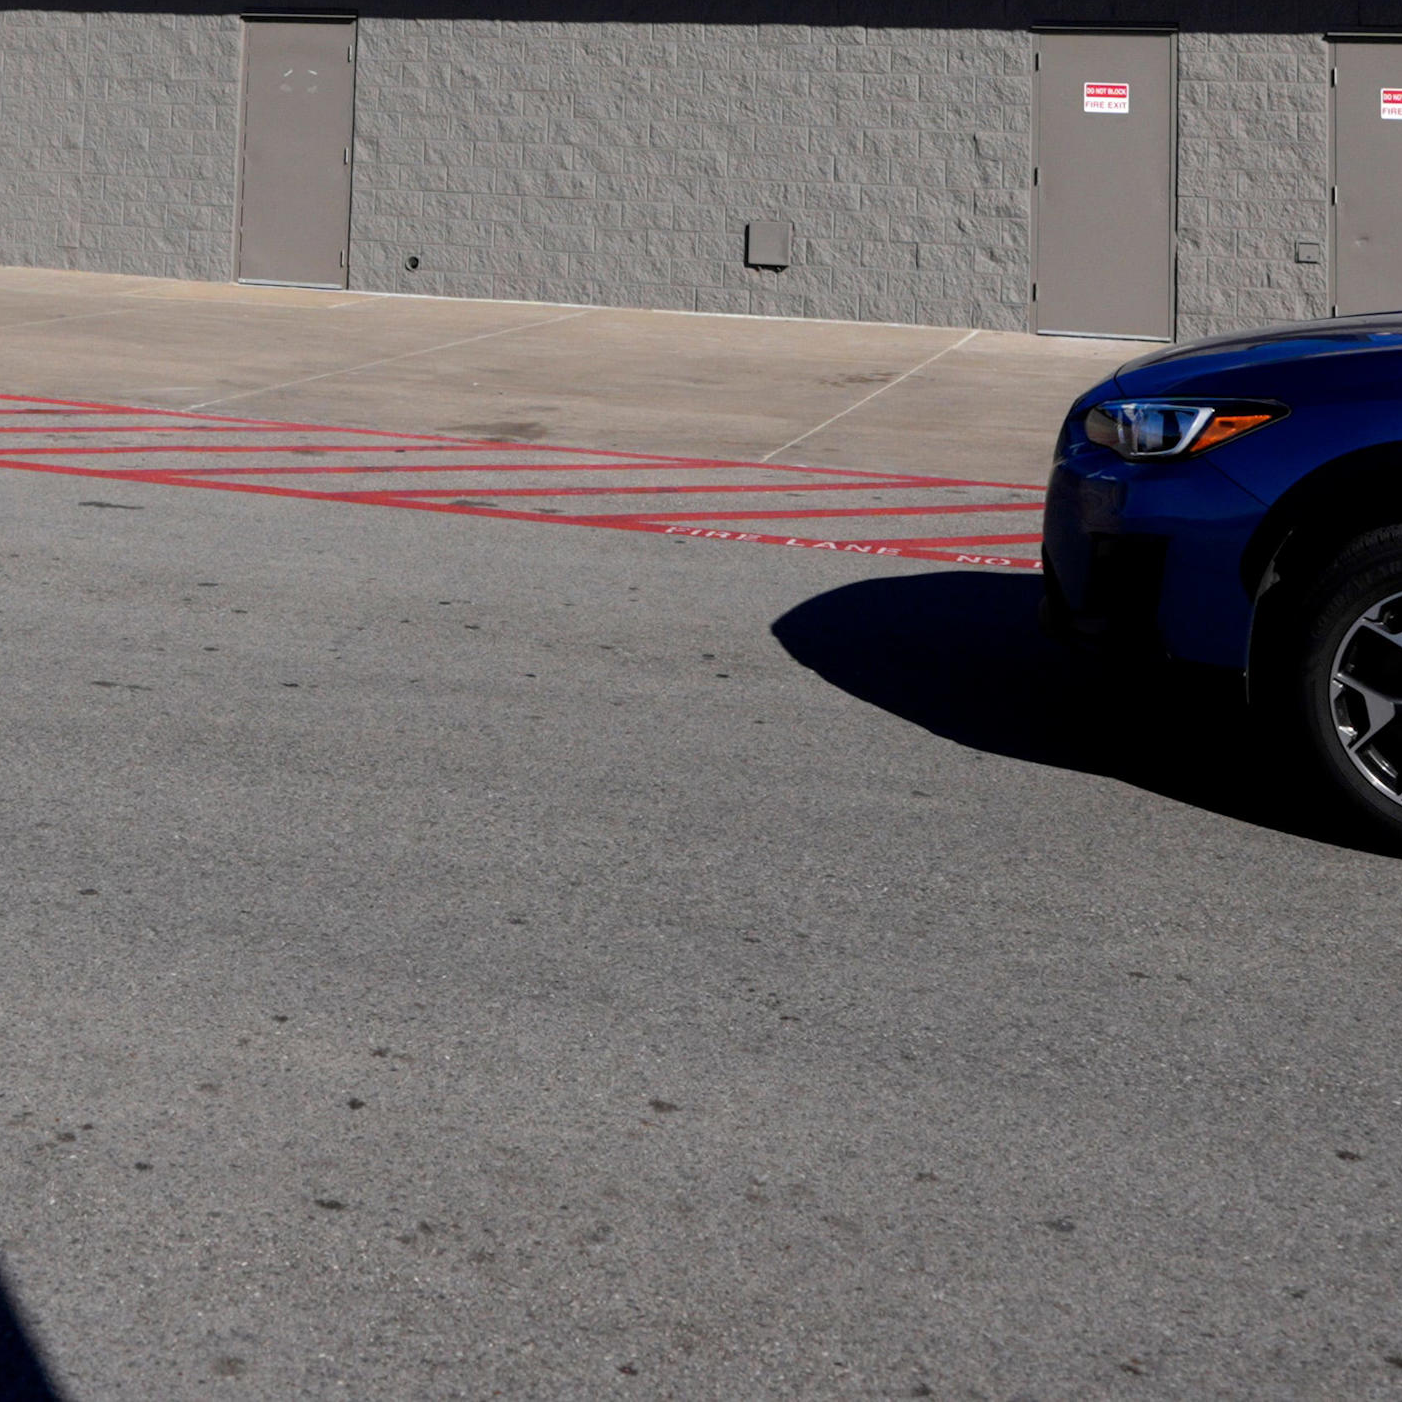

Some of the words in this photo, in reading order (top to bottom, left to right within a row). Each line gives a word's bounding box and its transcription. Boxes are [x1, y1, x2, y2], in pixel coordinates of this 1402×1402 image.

[1085, 101, 1105, 109] FIRE
[1108, 101, 1127, 109] EXIT
[665, 526, 762, 541] FIRE
[785, 538, 902, 556] LANE
[956, 555, 1011, 566] NO
